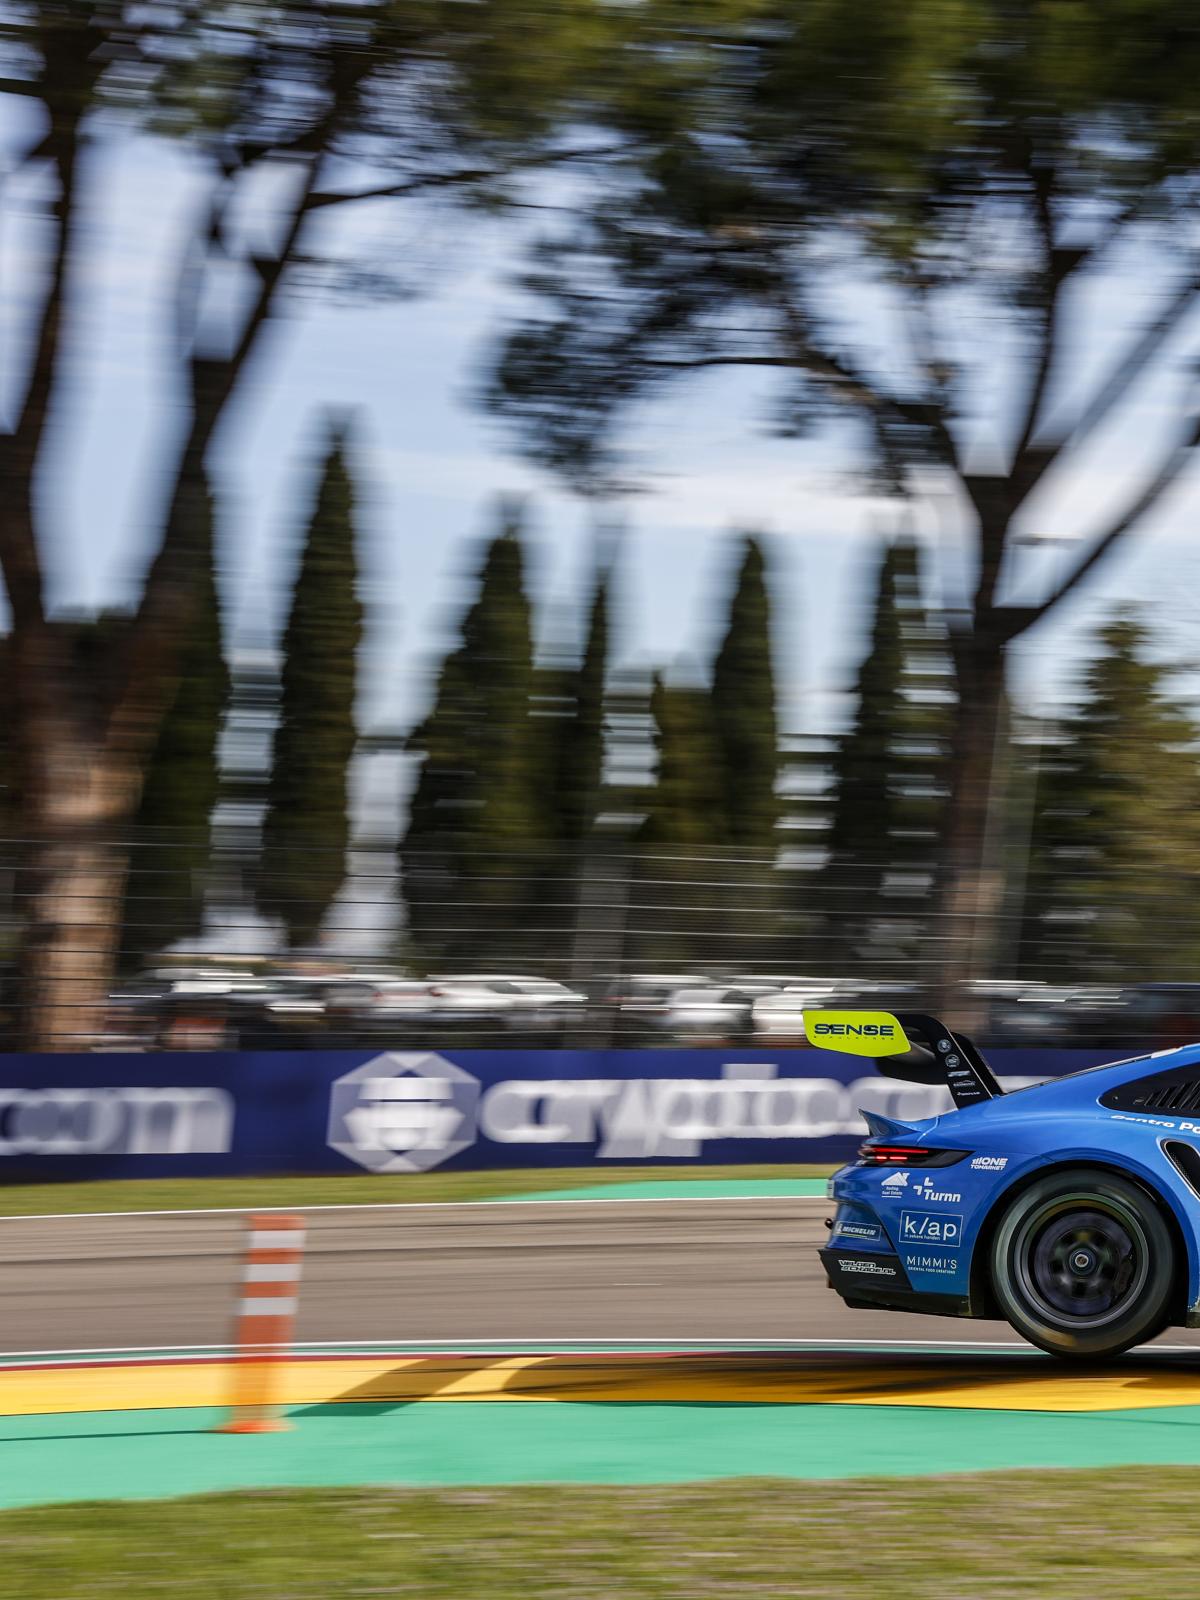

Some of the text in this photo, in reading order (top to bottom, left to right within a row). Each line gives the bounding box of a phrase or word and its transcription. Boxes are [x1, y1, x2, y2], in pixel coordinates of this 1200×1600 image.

[814, 1023, 895, 1036] SENSE
[924, 1189, 961, 1203] Turnn
[842, 1226, 877, 1236] MICHELIN
[904, 1215, 957, 1241] k/ap
[906, 1255, 957, 1269] MIMMI'S
